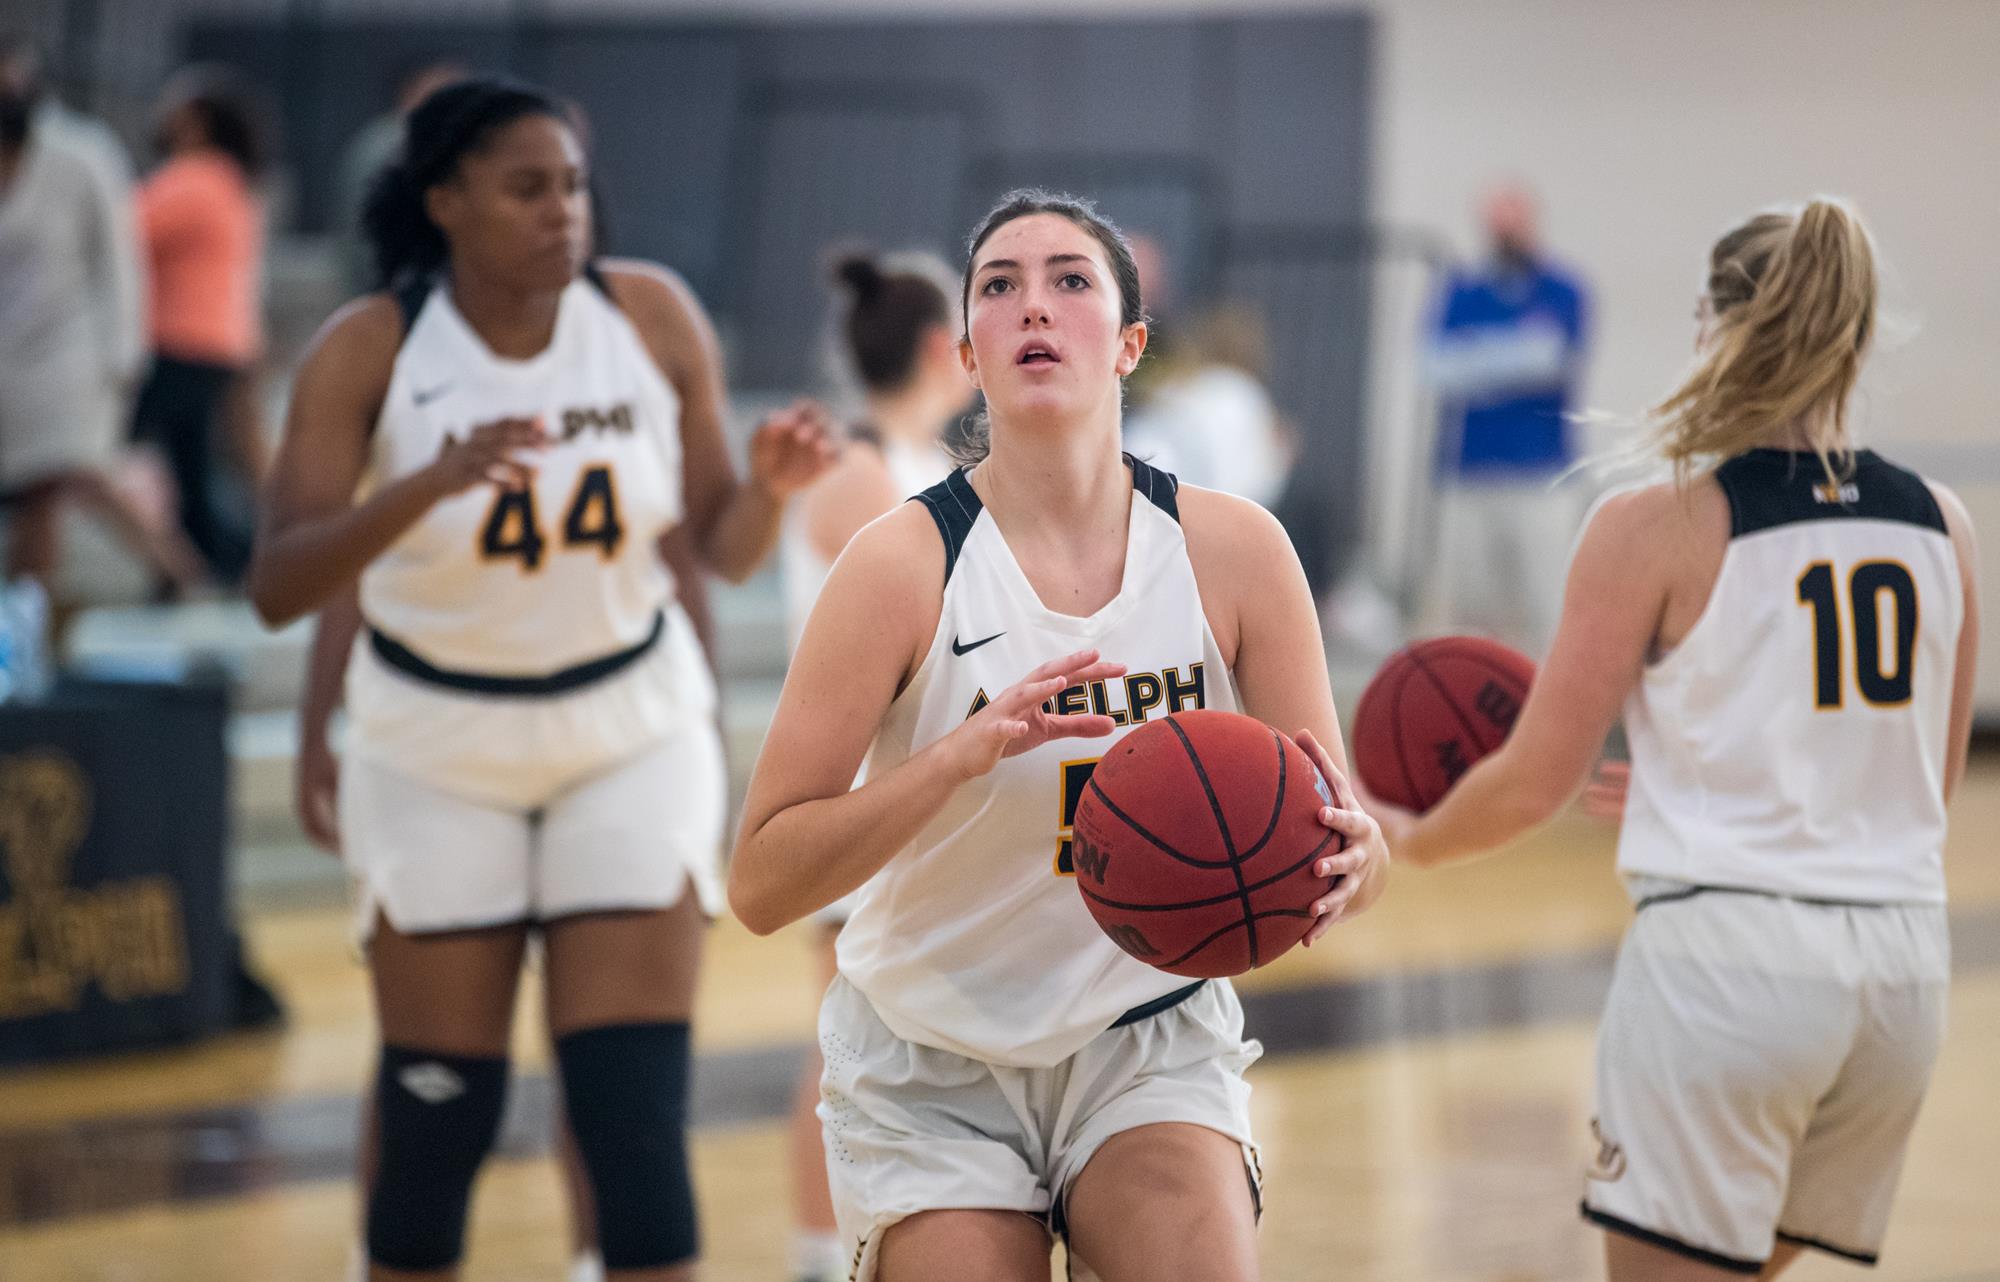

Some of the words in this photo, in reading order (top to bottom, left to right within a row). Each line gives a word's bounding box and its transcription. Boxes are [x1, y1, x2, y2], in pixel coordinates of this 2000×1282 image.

[477, 462, 625, 574] 44
[1795, 558, 1920, 711] 10
[964, 661, 1205, 729] ELPH
